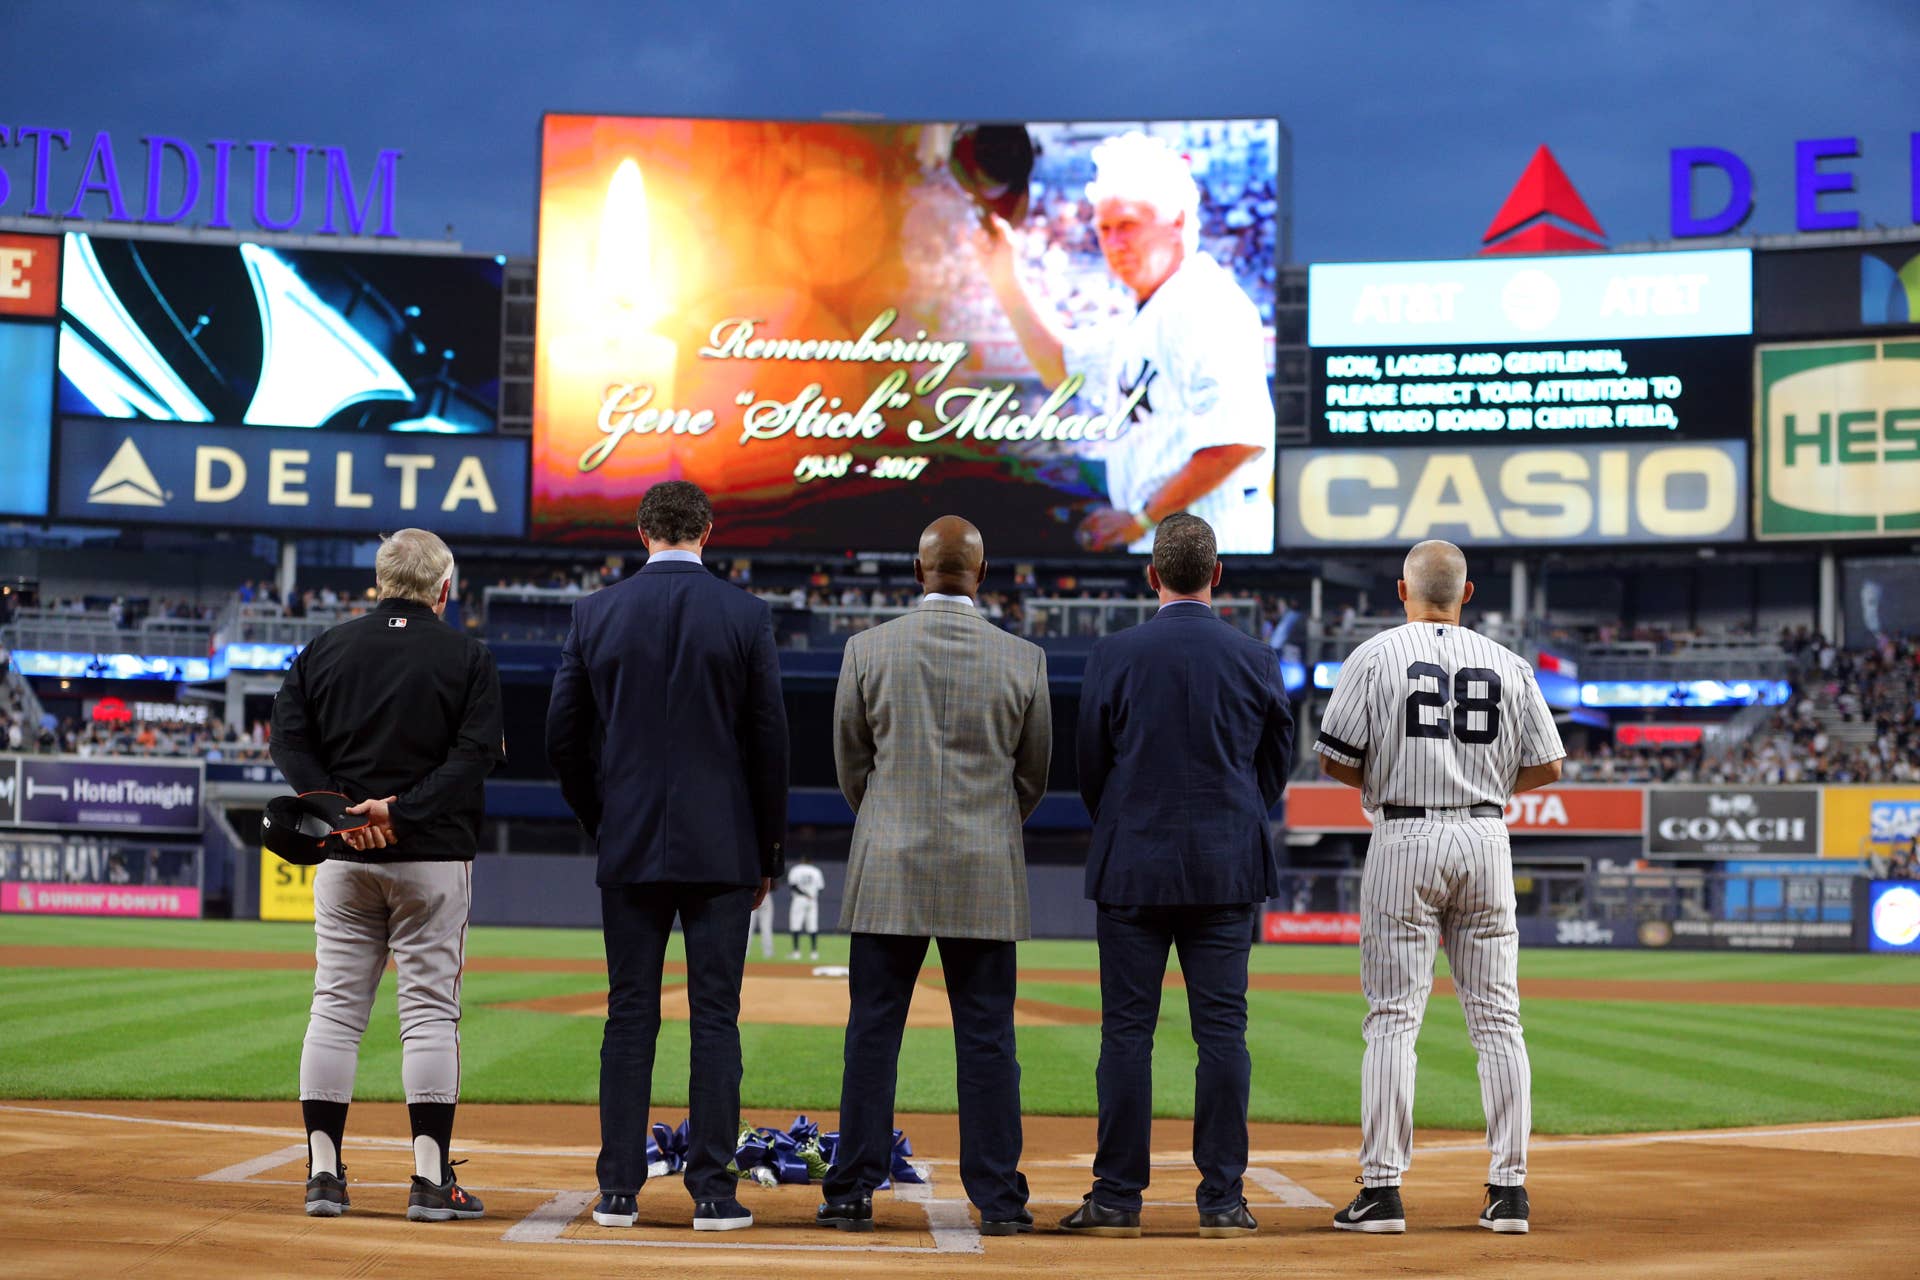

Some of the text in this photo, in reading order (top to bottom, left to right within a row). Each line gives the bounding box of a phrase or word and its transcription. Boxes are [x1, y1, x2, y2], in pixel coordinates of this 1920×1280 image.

[0, 124, 402, 238] TADIUM
[1670, 131, 1920, 239] DE
[698, 307, 967, 396] Remembering
[1326, 355, 1382, 380] NOW,
[1385, 354, 1456, 376] LADIES
[1457, 353, 1503, 375] AND
[1326, 376, 1682, 406] PLEASE DIRECT YOUR ATTENTION TO
[578, 382, 717, 473] Gene
[907, 372, 1147, 443] Michael
[1326, 404, 1679, 433] THE VIDEO BOARD IN CENTER FIELD,
[1783, 407, 1920, 467] HES
[194, 445, 498, 514] DELTA
[870, 455, 930, 481] 2017
[1298, 445, 1738, 542] CASIO
[134, 701, 209, 725] TERRACE
[1405, 660, 1502, 745] 28
[73, 777, 195, 810] HotelTonight
[1503, 793, 1569, 826] OTA
[1658, 817, 1806, 842] COACH
[275, 862, 317, 886] ST
[108, 893, 180, 912] DONUTS
